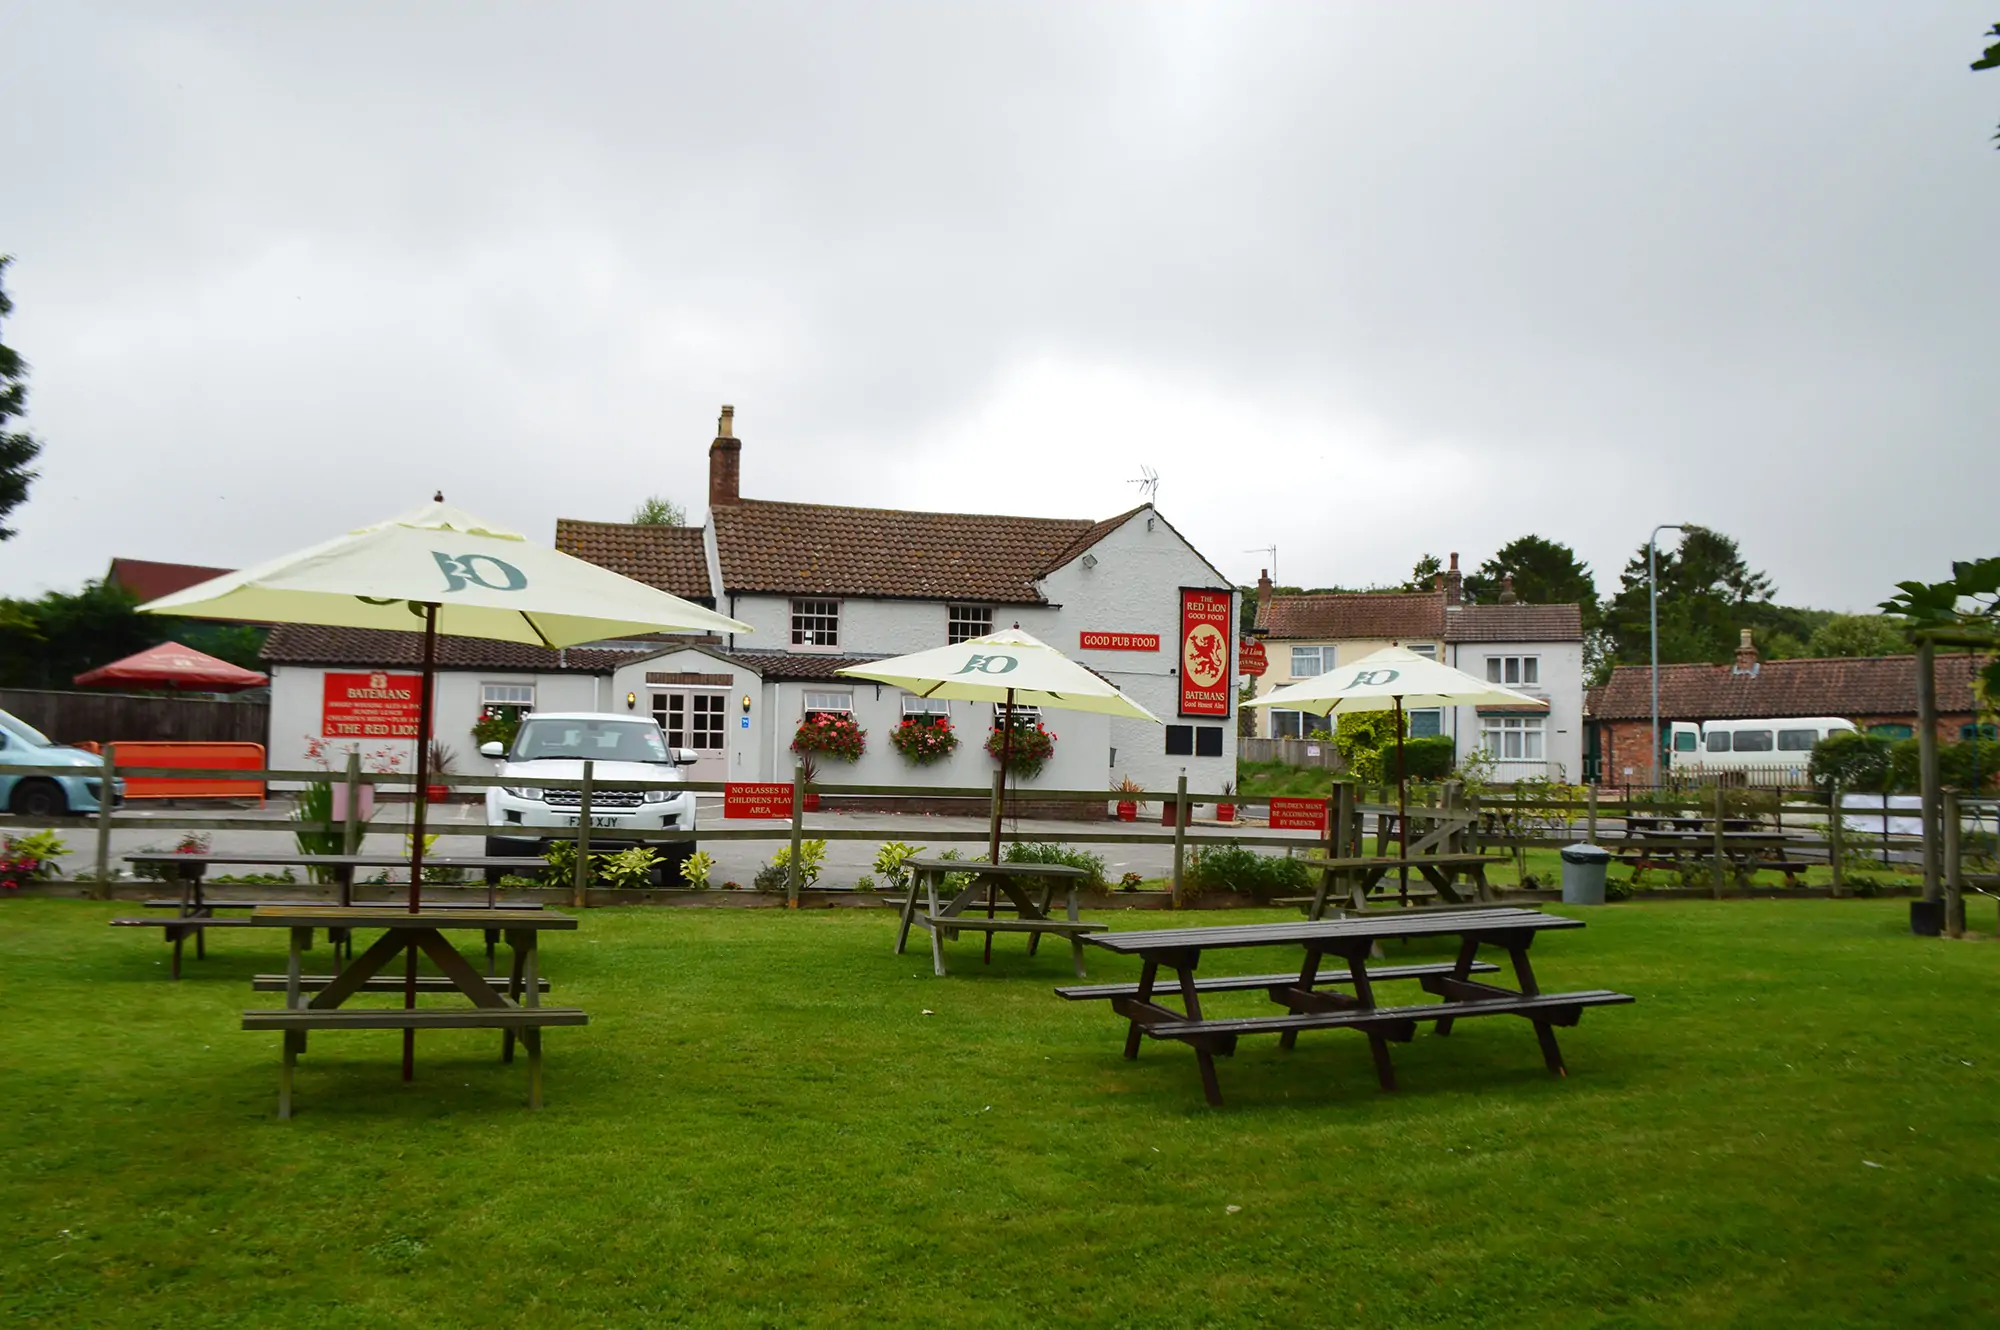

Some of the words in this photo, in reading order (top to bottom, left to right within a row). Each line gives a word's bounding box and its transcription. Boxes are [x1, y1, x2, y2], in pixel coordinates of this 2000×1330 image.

[1200, 595, 1214, 603] THE
[1187, 601, 1205, 611] RED
[1207, 603, 1227, 612] LION
[1188, 612, 1206, 620] GOOD
[1207, 613, 1225, 621] FOOD
[1084, 635, 1110, 646] GOOD
[1112, 636, 1130, 647] PUB
[1132, 637, 1156, 648] FOOD
[1249, 647, 1263, 656] Lion
[347, 688, 411, 700] BATEMANS
[1185, 690, 1225, 702] BATEMANS
[337, 723, 361, 735] THE
[364, 723, 389, 736] RED
[391, 724, 419, 736] LION
[731, 786, 744, 794] NO
[744, 786, 780, 795] GLASSES
[781, 787, 790, 795] IN
[728, 796, 772, 804] CHILDRENS
[749, 806, 771, 814] AREA
[1281, 810, 1324, 819] ACCOMPANIED
[597, 816, 618, 828] XJY
[1289, 819, 1316, 827] PARENTS
